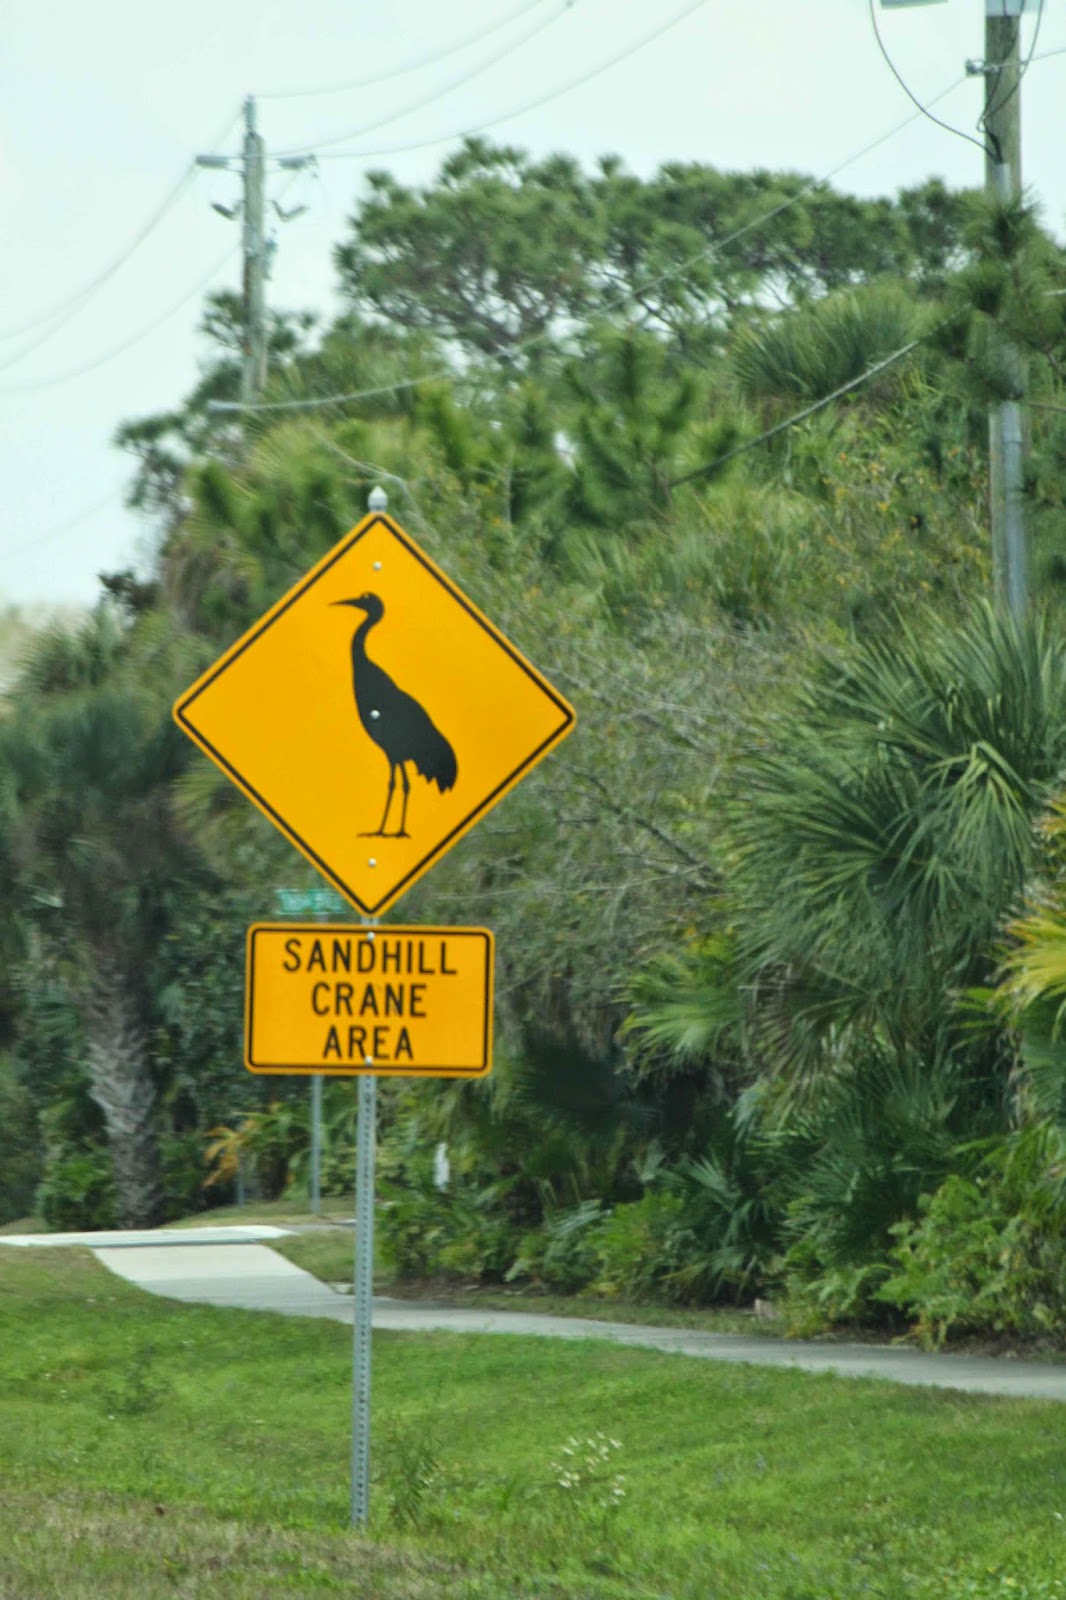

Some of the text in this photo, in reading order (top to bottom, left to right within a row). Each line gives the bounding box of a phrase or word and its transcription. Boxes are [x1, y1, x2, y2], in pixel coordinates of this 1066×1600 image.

[283, 938, 457, 975] SANDHILL
[312, 981, 427, 1018] CRANE
[323, 1025, 414, 1061] AREA
